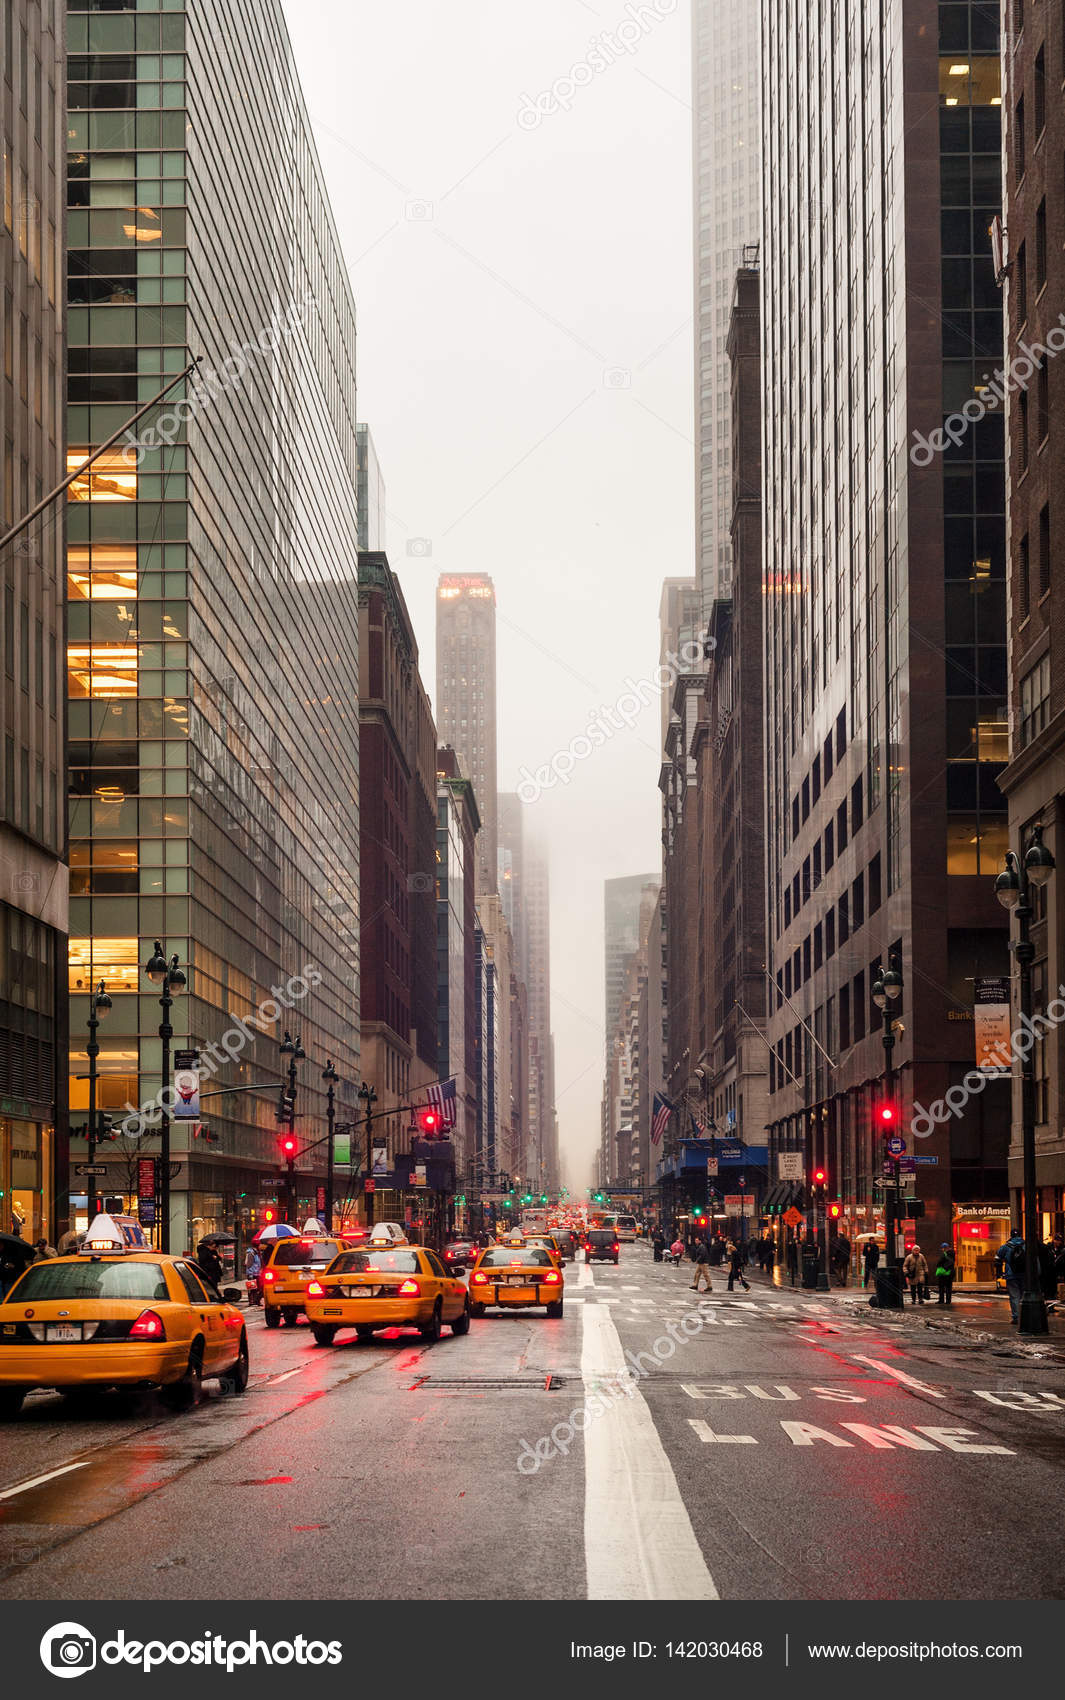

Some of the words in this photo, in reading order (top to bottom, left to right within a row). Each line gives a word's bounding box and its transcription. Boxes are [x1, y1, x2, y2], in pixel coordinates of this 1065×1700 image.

[947, 1010, 972, 1020] Bank
[958, 1207, 978, 1215] Bank
[978, 1207, 986, 1215] of
[680, 1384, 867, 1403] BUS
[687, 1418, 1017, 1455] LANE
